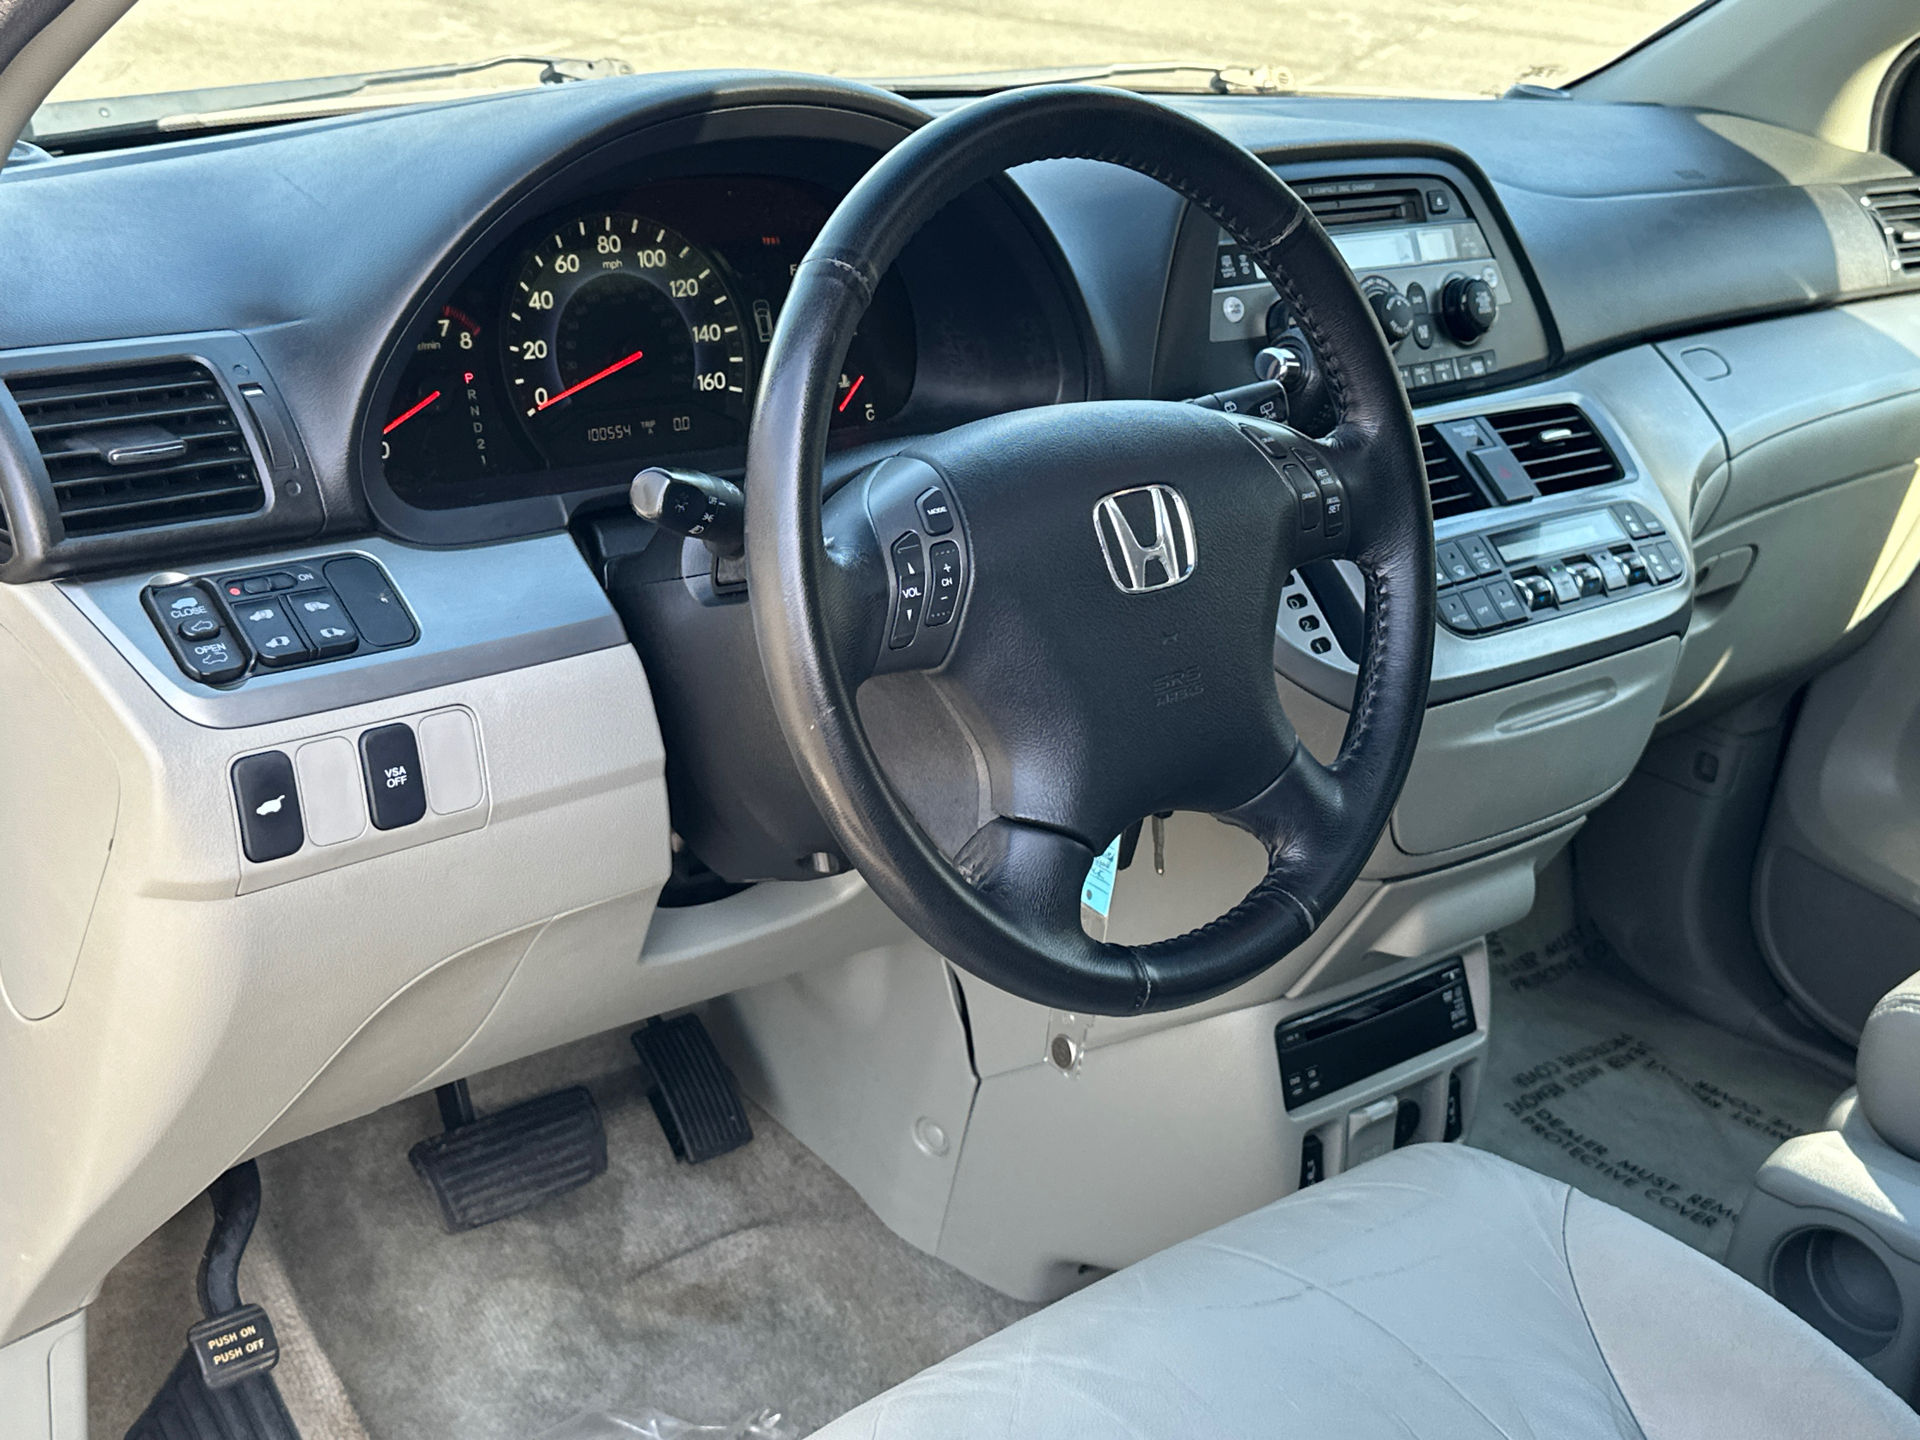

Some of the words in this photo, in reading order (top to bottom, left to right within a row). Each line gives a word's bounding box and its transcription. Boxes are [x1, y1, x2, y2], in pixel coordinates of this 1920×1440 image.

[596, 235, 621, 254] 80
[554, 254, 580, 274] 60
[602, 258, 623, 270] mph
[636, 248, 667, 269] 100
[669, 278, 699, 298] 120
[528, 290, 554, 310] 40
[437, 319, 450, 337] 7
[692, 323, 722, 343] 140
[460, 331, 473, 350] 8
[523, 340, 548, 360] 20
[463, 371, 475, 384] P
[697, 372, 726, 391] 160
[467, 389, 477, 401] R
[534, 387, 548, 407] 0
[470, 405, 480, 416] N
[865, 408, 876, 422] C
[473, 422, 483, 434] D
[587, 423, 632, 442] 100554
[476, 438, 486, 450] 2
[927, 505, 948, 515] MODE
[1328, 504, 1341, 515] SET
[297, 571, 314, 582] ON
[941, 577, 953, 588] CH
[902, 586, 922, 599] VOL
[1288, 598, 1300, 610] D
[170, 605, 208, 620] CLOSE
[1301, 620, 1313, 632] 2
[194, 641, 227, 656] OPEN
[1315, 641, 1324, 653] 1
[384, 765, 407, 779] VSA
[386, 775, 408, 789] OFF
[1535, 1107, 1608, 1155] DEALER
[1616, 1159, 1682, 1192] MUST
[1520, 1115, 1640, 1191] PROTECTIVE
[1644, 1188, 1718, 1228] COVER
[207, 1332, 238, 1350] PUSH
[240, 1325, 257, 1338] ON
[213, 1347, 243, 1366] PUSH
[245, 1338, 265, 1353] OFF
